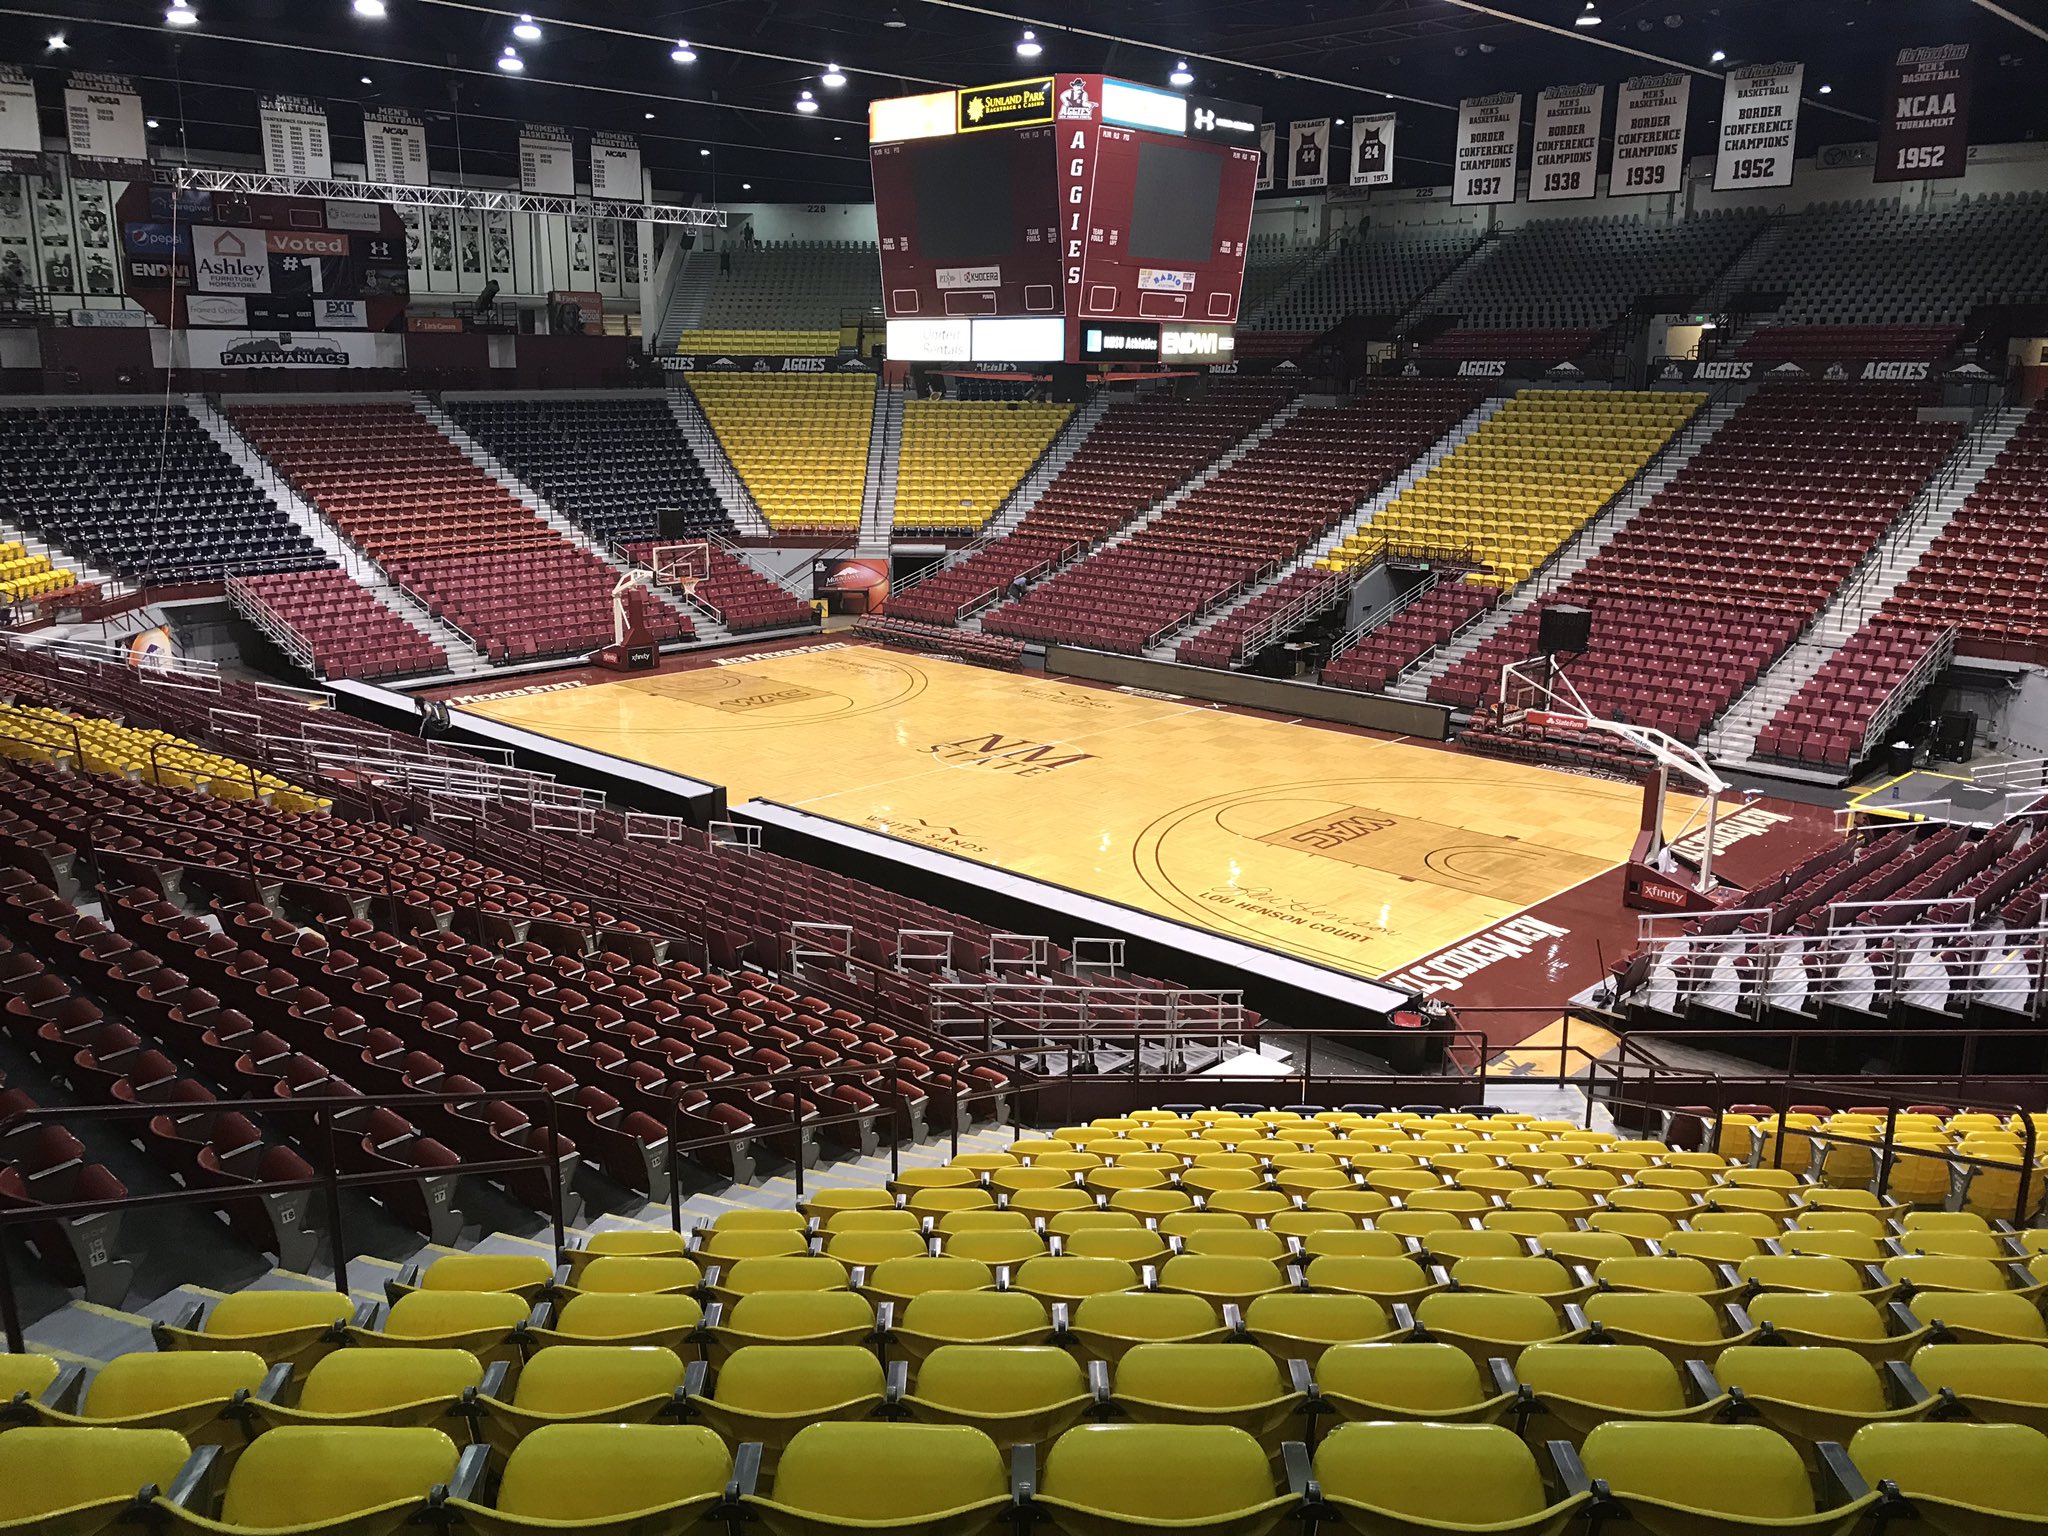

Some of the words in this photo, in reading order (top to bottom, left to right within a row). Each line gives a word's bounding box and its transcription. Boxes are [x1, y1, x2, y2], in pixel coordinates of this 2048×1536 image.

[1918, 62, 1945, 72] MEN'S
[72, 70, 130, 85] WOMEN'S
[1751, 78, 1776, 88] MEN'S
[1902, 70, 1960, 84] BASKETBALL
[67, 79, 136, 94] VOLLEYBALL
[1737, 86, 1789, 99] BASKETBALL
[87, 95, 120, 105] NCAA
[276, 94, 309, 105] MEN'S
[985, 95, 1022, 107] SUNLAND
[1023, 91, 1045, 103] PARK
[1642, 89, 1665, 99] MEN'S
[260, 100, 325, 115] BASKETBALL
[1559, 99, 1580, 108] MEN'S
[1629, 97, 1677, 109] BASKETBALL
[1896, 93, 1957, 118] NCAA
[378, 106, 409, 117] MEN'S
[1480, 107, 1499, 115] MEN'S
[1547, 106, 1591, 117] BASKETBALL
[1738, 106, 1782, 120] BORDER
[364, 112, 423, 126] BASKETBALL
[1469, 114, 1510, 124] BASKETBALL
[1630, 115, 1671, 129] BORDER
[1896, 117, 1955, 130] TOURNAMENT
[382, 126, 409, 135] NCAA
[525, 123, 565, 134] WOMEN'S
[1548, 124, 1585, 137] BORDER
[1724, 119, 1794, 136] CONFERENCE
[519, 130, 571, 142] BASKETBALL
[596, 131, 634, 141] WOMEN'S
[1470, 131, 1505, 143] BORDER
[1618, 129, 1681, 145] CONFERENCE
[1725, 135, 1790, 151] CHAMPIONS
[591, 138, 639, 149] BASKETBALL
[1536, 137, 1595, 152] CONFERENCE
[605, 150, 627, 158] NCAA
[1301, 149, 1316, 163] 44
[1365, 145, 1379, 159] 24
[1459, 144, 1514, 158] CONFERENCE
[1618, 144, 1678, 159] CHAMPIONS
[1897, 145, 1945, 169] 1952
[1460, 158, 1511, 170] CHAMPIONS
[1537, 152, 1592, 166] CHAMPIONS
[1626, 165, 1665, 186] 1939
[1733, 158, 1775, 180] 1952
[1467, 177, 1501, 196] 1937
[1544, 172, 1580, 191] 1938
[1416, 188, 1434, 197] 225
[169, 202, 211, 213] caregiver
[807, 205, 826, 213] 228
[1068, 131, 1086, 284] AGGIES
[150, 234, 182, 245] pepsi
[273, 236, 343, 253] Voted
[52, 265, 69, 278] 20
[131, 262, 190, 278] ENDWI
[199, 258, 265, 280] Ashley
[282, 256, 324, 293] #1
[970, 272, 999, 281] KYOCERA
[1153, 273, 1182, 286] RADIO
[326, 301, 354, 313] EXIT
[97, 311, 142, 320] CITIZENS
[1665, 315, 1690, 324] EAST
[100, 319, 127, 327] BANK
[1161, 332, 1218, 354] ENDWI
[222, 352, 346, 364] PANAMANIACS
[781, 358, 826, 371] AGGIES
[1457, 361, 1506, 376] AGGIES
[1693, 362, 1753, 379] AGGIES
[1860, 362, 1931, 380] AGGIES
[631, 653, 650, 662] xfinity
[711, 655, 752, 666] NEW
[750, 649, 802, 661] MEXICO
[799, 642, 850, 654] STATE
[454, 689, 527, 704] MEXICO
[524, 680, 588, 695] STATE
[719, 689, 811, 707] WAC
[1622, 730, 1651, 749] Schelde
[948, 733, 1103, 769] NM
[916, 743, 1053, 778] STATE
[866, 815, 922, 833] WHITE
[926, 833, 988, 852] SANDS
[1290, 816, 1397, 850] WAC
[1645, 886, 1685, 903] xfinity
[1198, 891, 1236, 904] LOU
[1235, 901, 1308, 925] HENSON
[1309, 922, 1374, 944] COURT
[1493, 914, 1571, 946] NEW
[1424, 932, 1533, 979] MEXICO
[436, 1192, 444, 1200] 17
[283, 1210, 295, 1221] 18
[91, 1251, 105, 1262] 19
